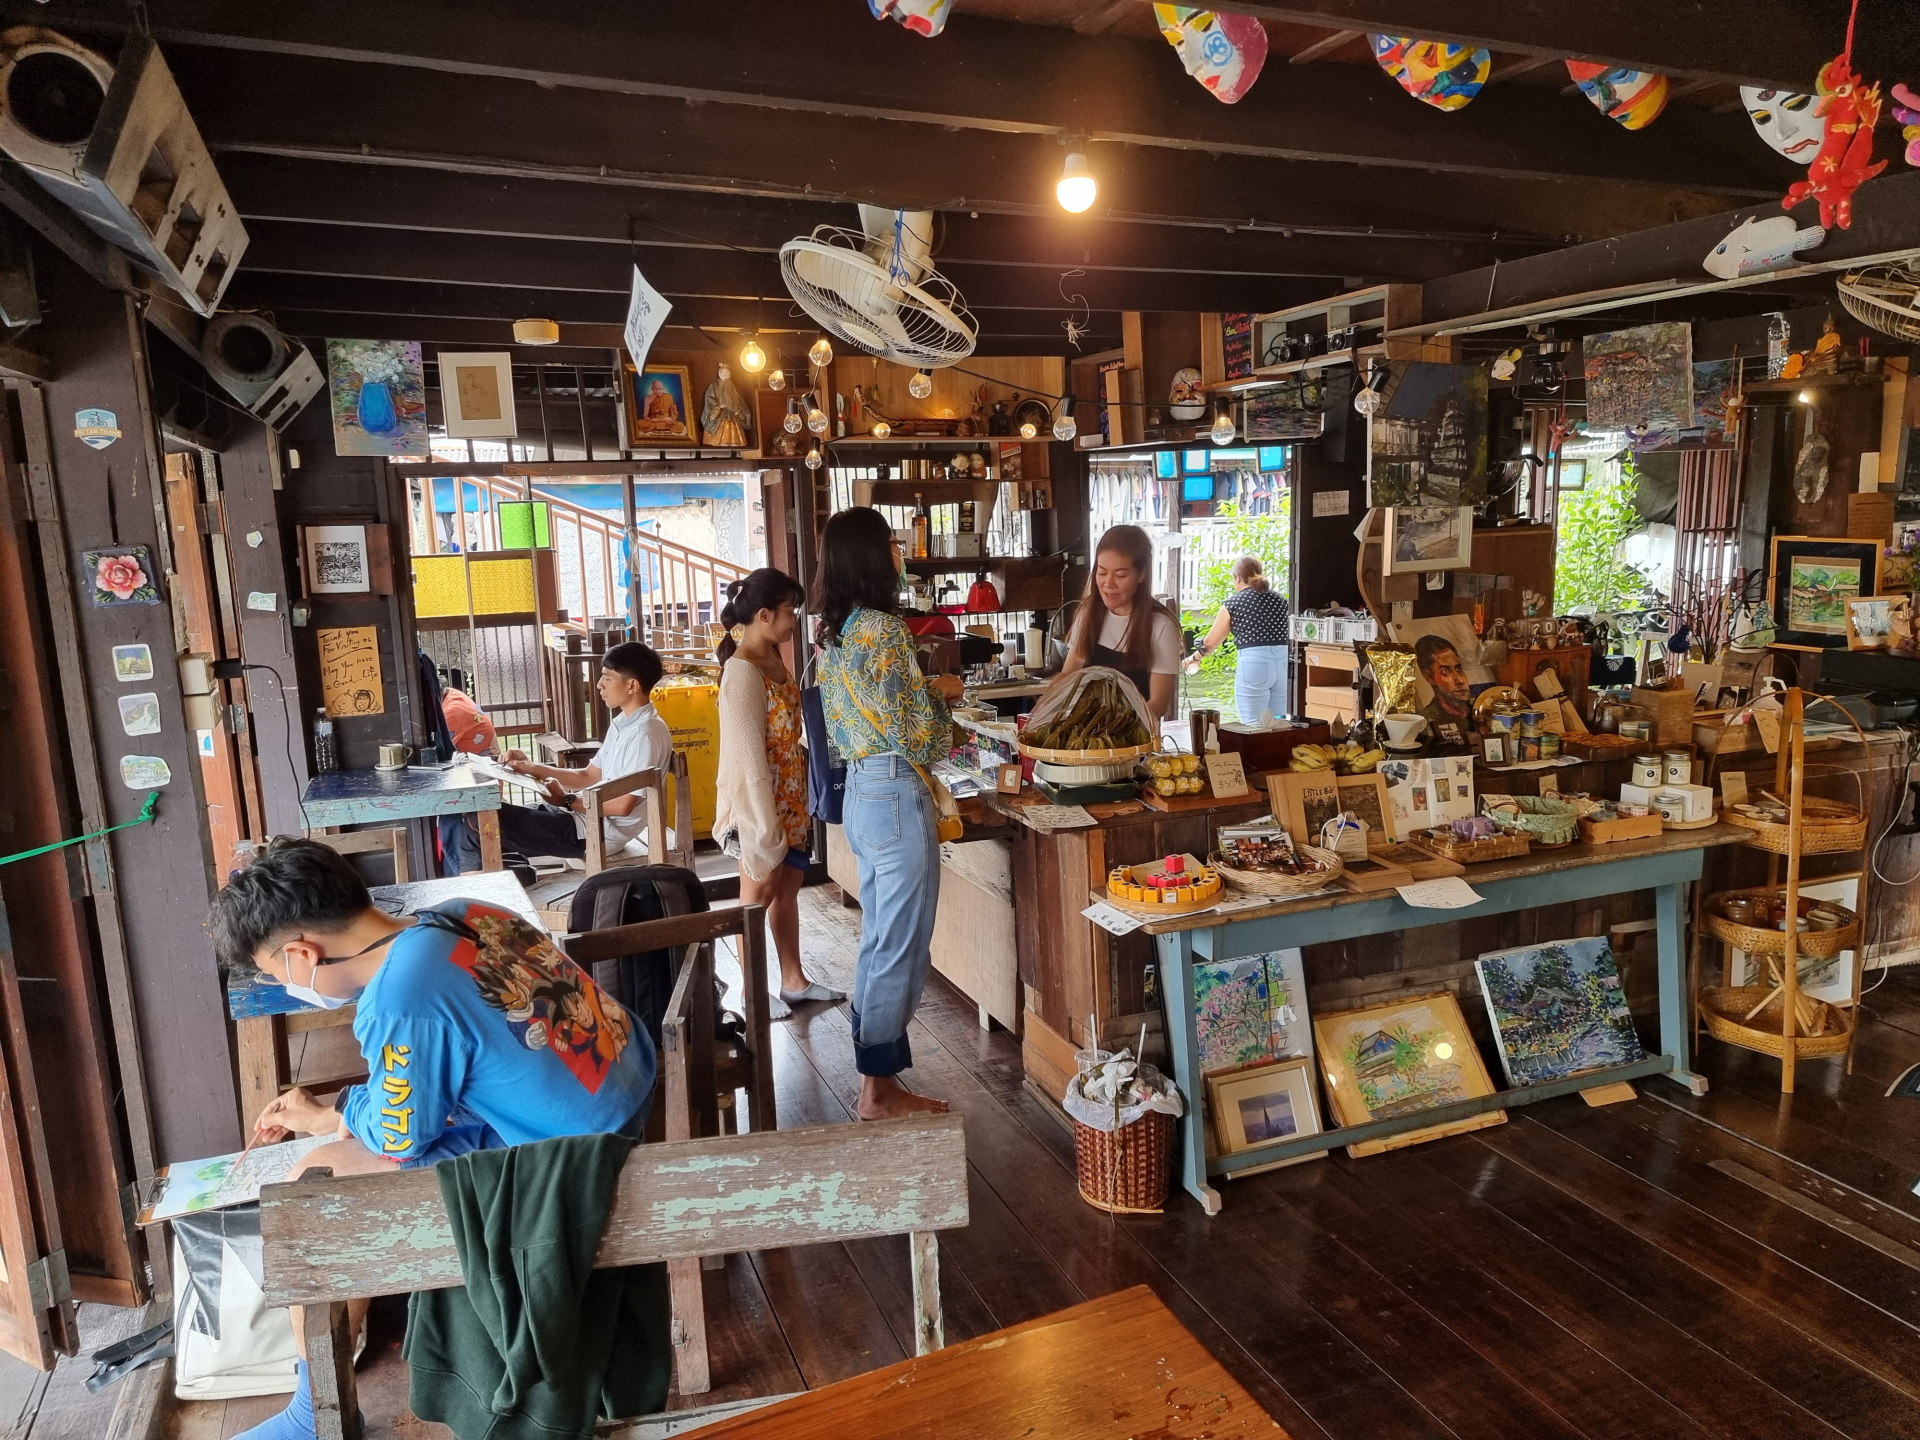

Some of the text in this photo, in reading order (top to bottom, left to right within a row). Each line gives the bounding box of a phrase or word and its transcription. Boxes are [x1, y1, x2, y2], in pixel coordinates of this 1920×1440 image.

[319, 630, 342, 644] Thank
[323, 643, 335, 657] For
[323, 665, 338, 680] May
[333, 674, 354, 689] Good
[362, 665, 379, 682] Life
[1303, 788, 1323, 799] LITTLE
[382, 1044, 414, 1153] ドラゴン
